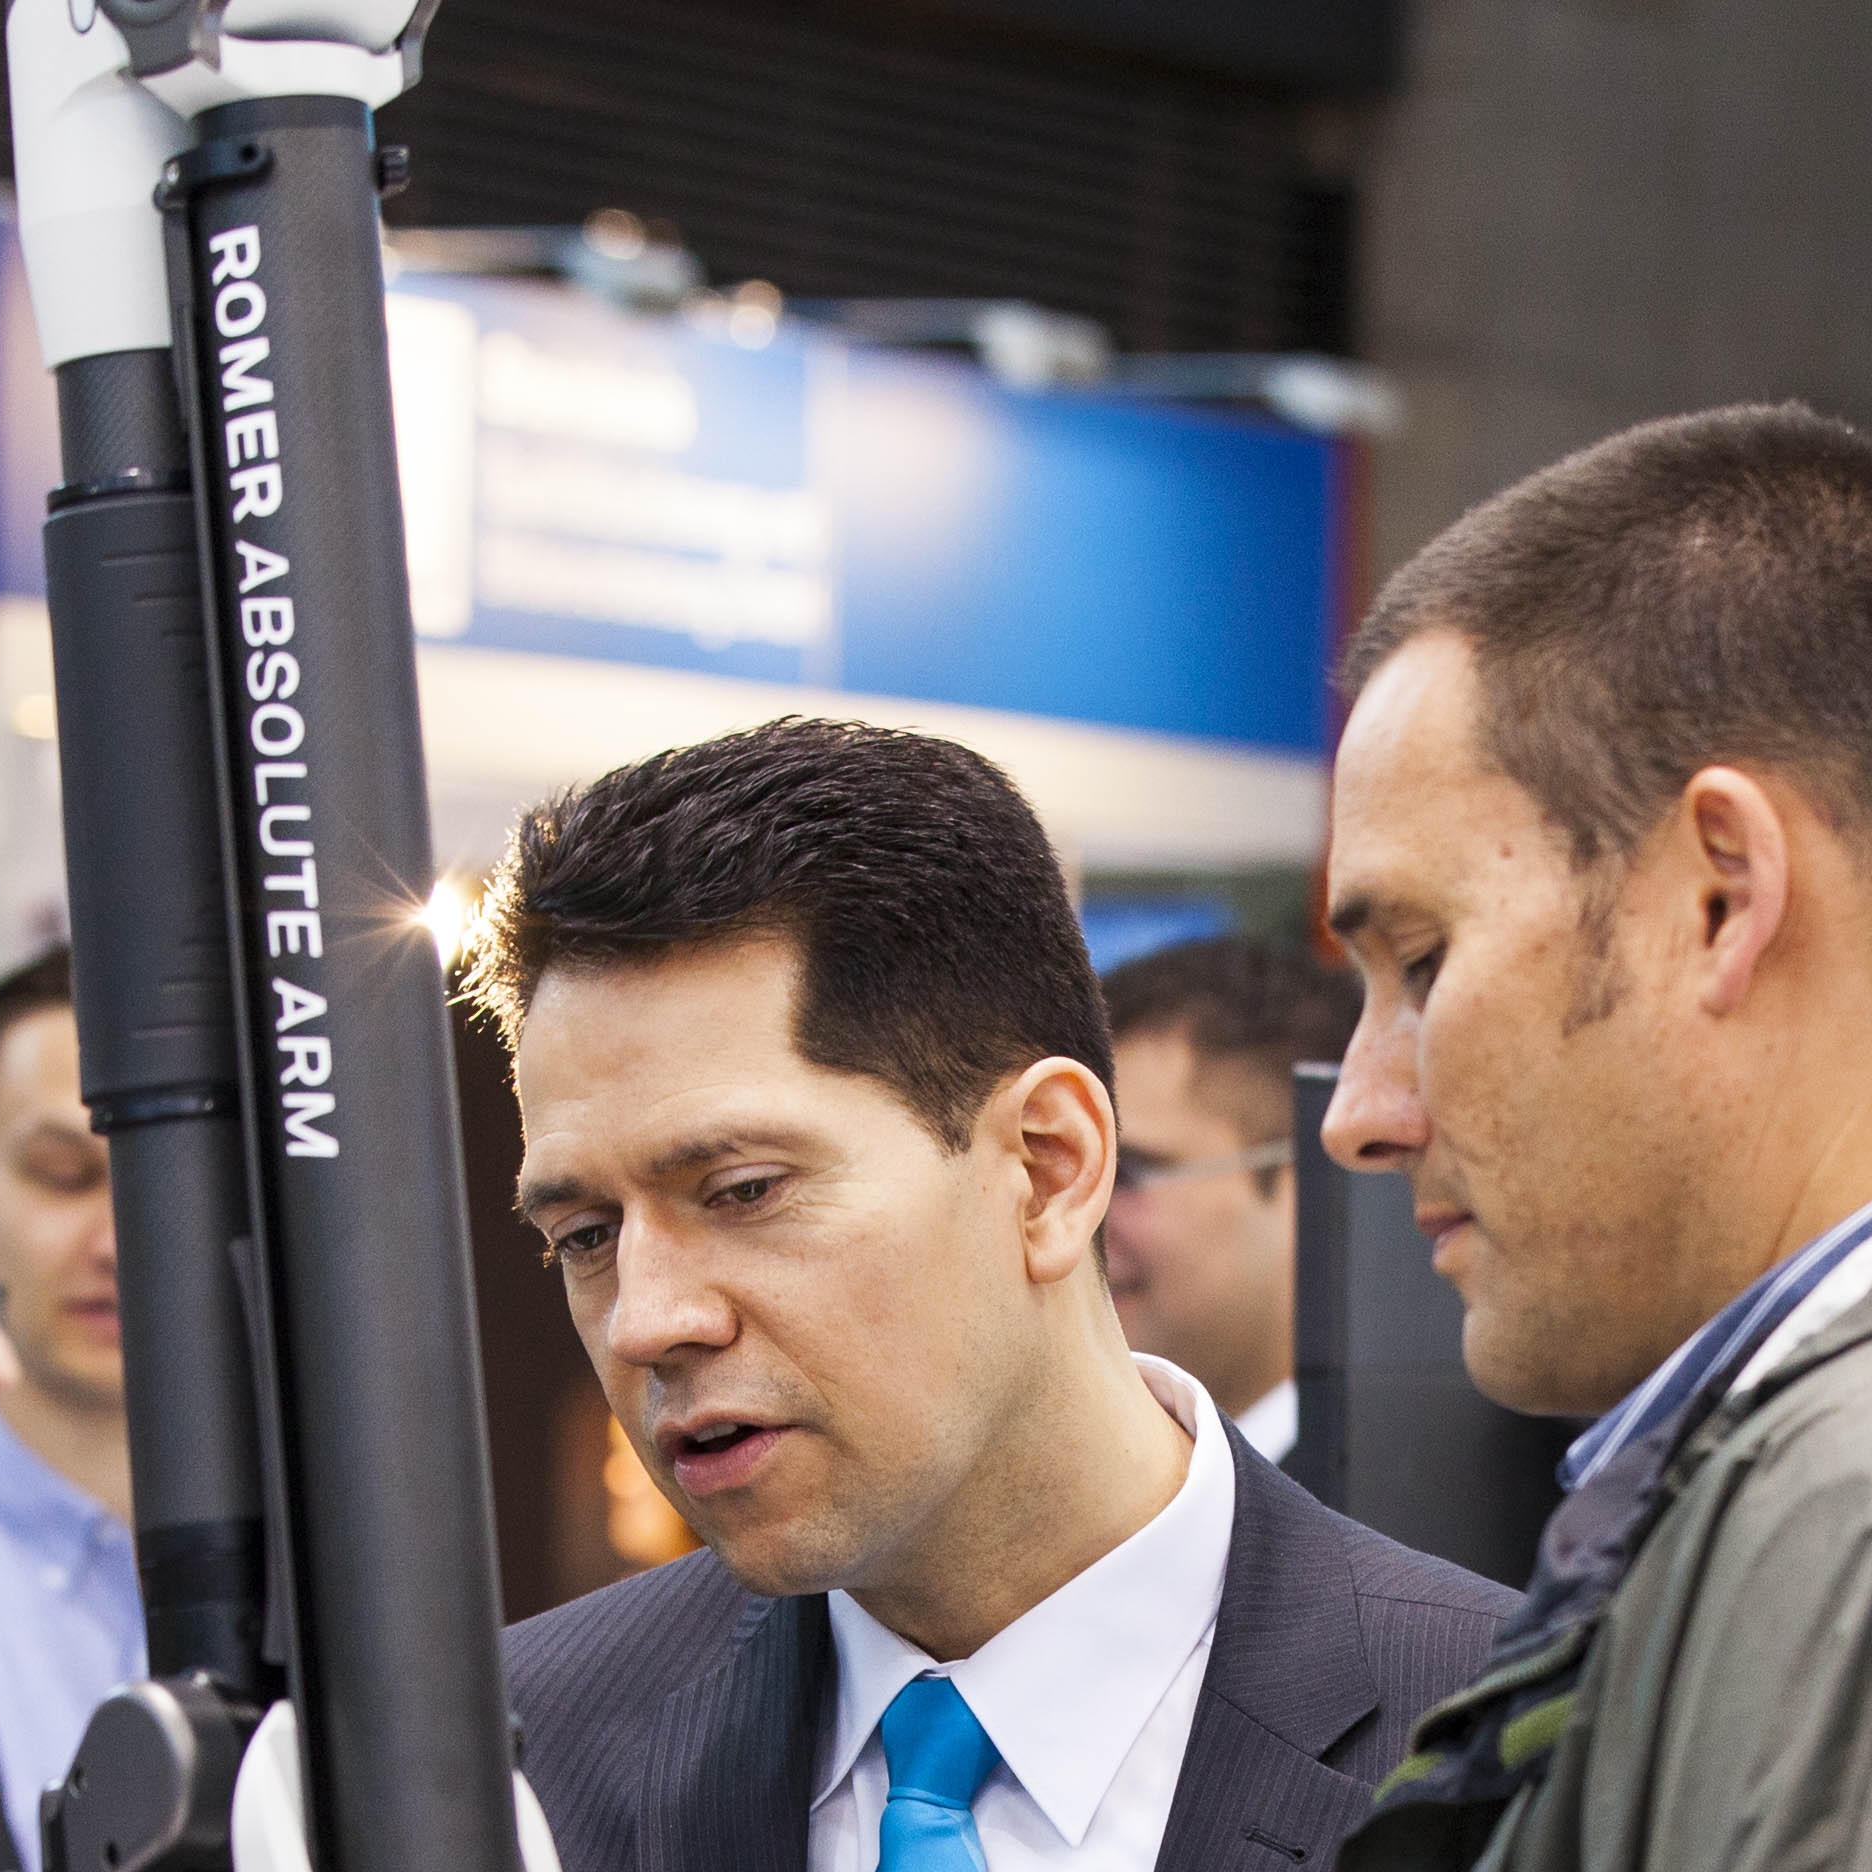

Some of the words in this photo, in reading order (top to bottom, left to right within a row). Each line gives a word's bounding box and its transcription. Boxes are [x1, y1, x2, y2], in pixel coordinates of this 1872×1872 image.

[208, 226, 284, 523] ROMER
[234, 540, 324, 960] ABSOLUTE
[271, 977, 340, 1159] ARM
